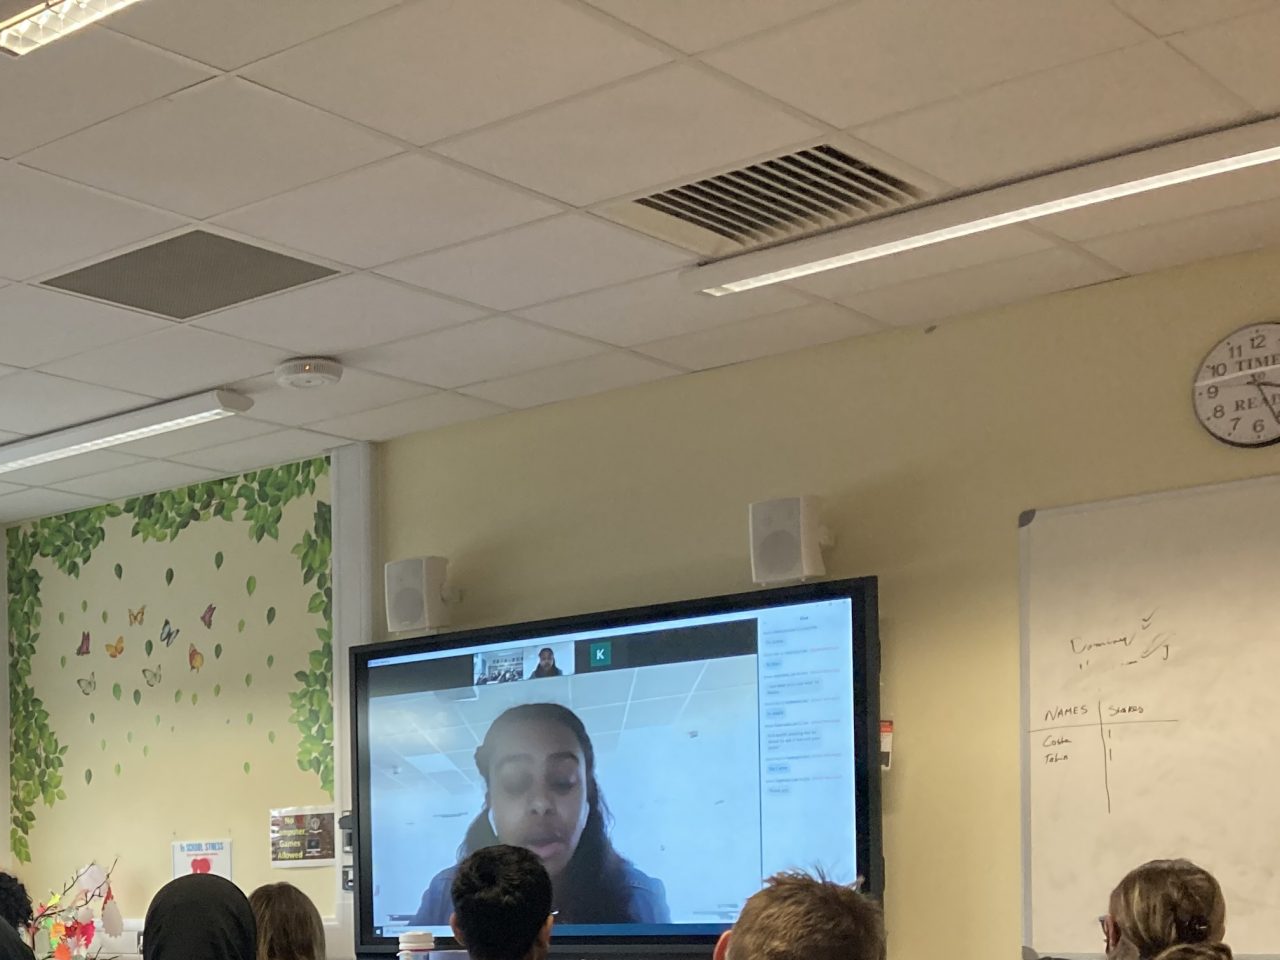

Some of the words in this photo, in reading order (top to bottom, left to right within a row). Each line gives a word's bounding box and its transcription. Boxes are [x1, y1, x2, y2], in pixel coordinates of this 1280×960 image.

[1250, 334, 1267, 349] 12
[1228, 345, 1243, 359] 11
[1210, 362, 1228, 377] 10
[1207, 385, 1219, 399] 9
[1213, 404, 1225, 419] 8
[1230, 417, 1241, 431] 7
[1253, 419, 1265, 433] 6
[596, 648, 605, 660] K
[1045, 704, 1088, 721] NAMES
